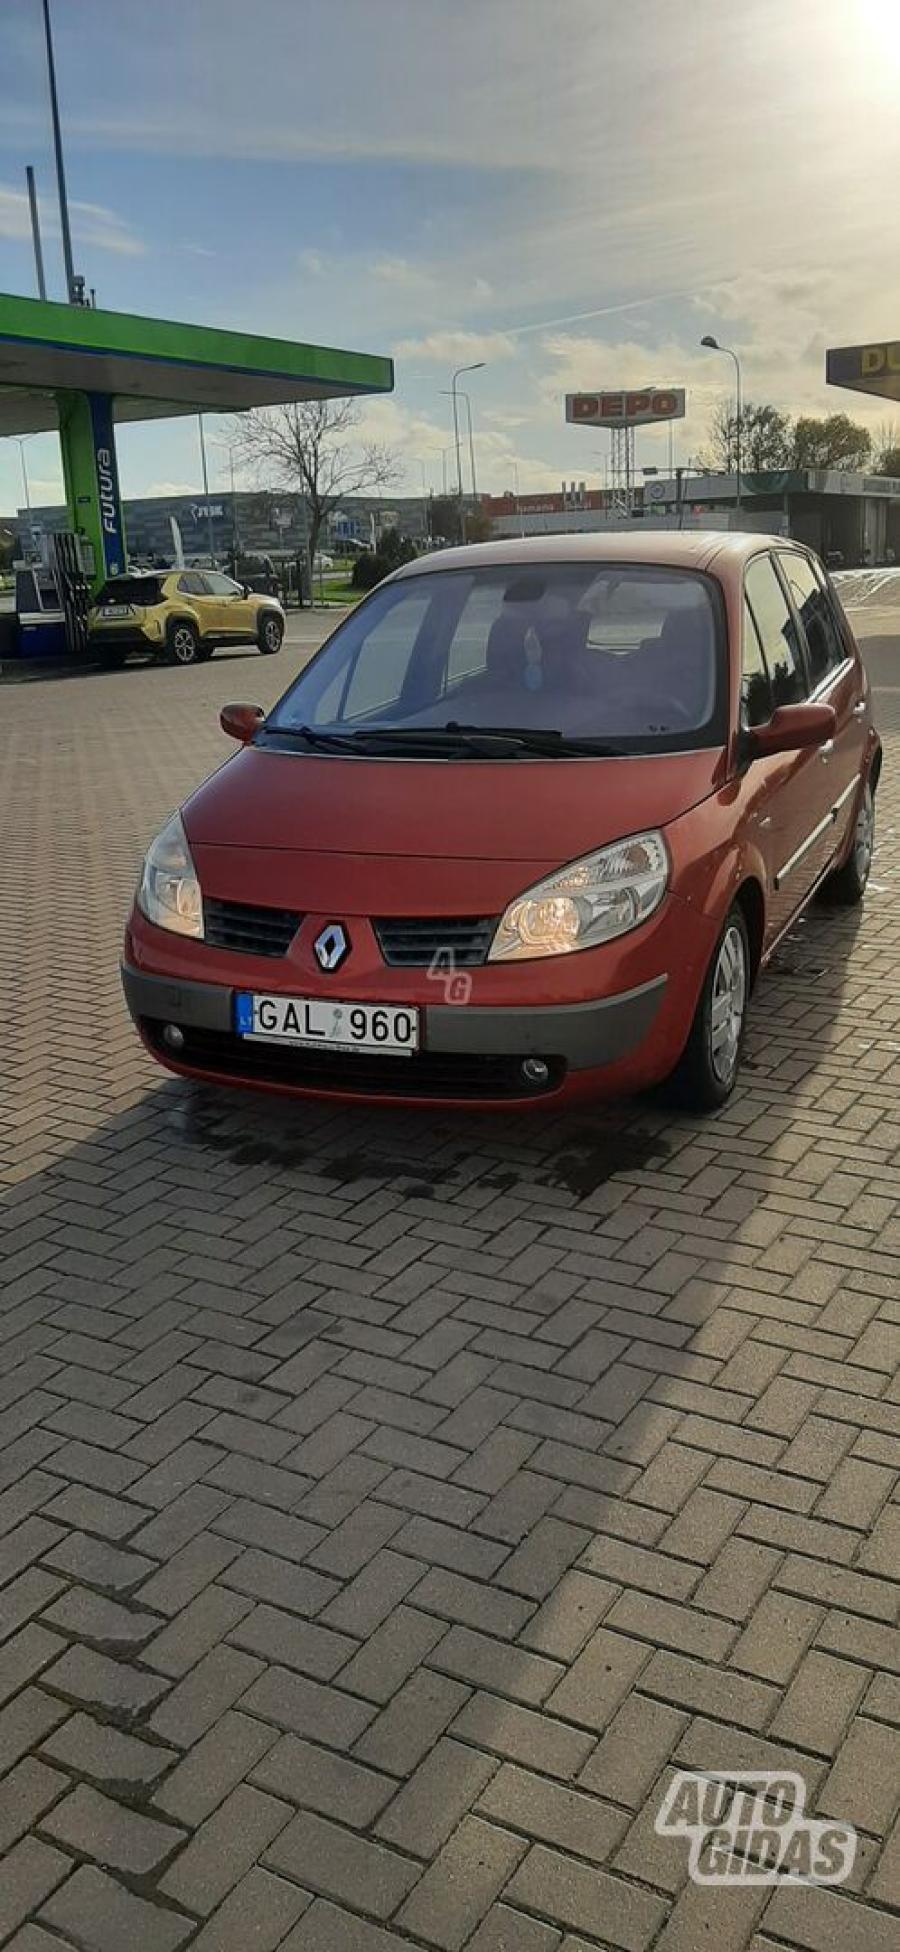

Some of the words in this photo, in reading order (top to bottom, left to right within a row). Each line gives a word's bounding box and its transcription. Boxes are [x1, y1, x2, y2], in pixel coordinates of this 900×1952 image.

[572, 393, 676, 418] DEPO
[98, 448, 116, 533] Futura
[259, 1000, 325, 1035] GAL
[350, 1009, 411, 1042] 960
